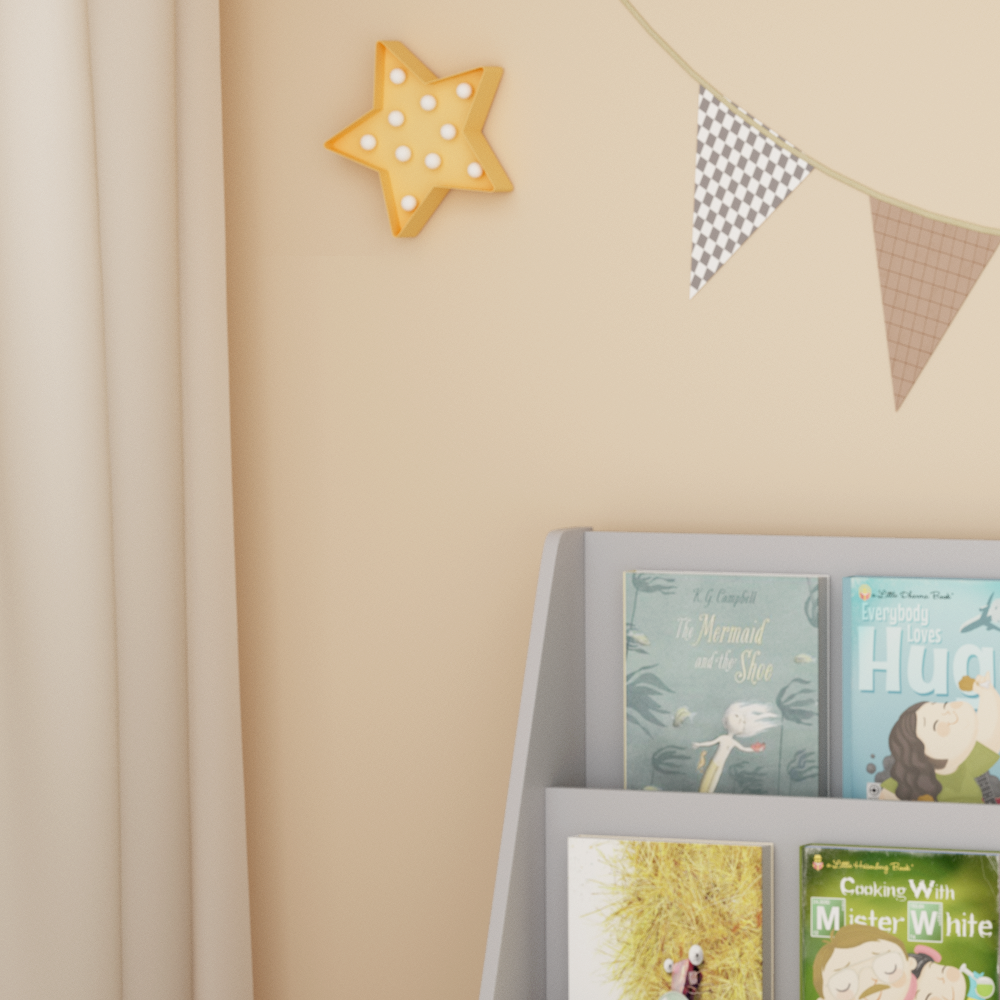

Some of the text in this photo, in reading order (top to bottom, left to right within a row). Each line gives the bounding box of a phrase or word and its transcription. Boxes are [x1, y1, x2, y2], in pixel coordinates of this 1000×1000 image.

[715, 588, 757, 607] Campbell
[877, 588, 898, 599] Little
[861, 602, 929, 626] Everybody
[675, 613, 770, 646] The Mermaid
[906, 624, 942, 645] Loves
[694, 649, 773, 685] and the Shoe
[831, 858, 853, 870] Little
[840, 876, 955, 902] Cooking With
[815, 905, 994, 939] Mister White
